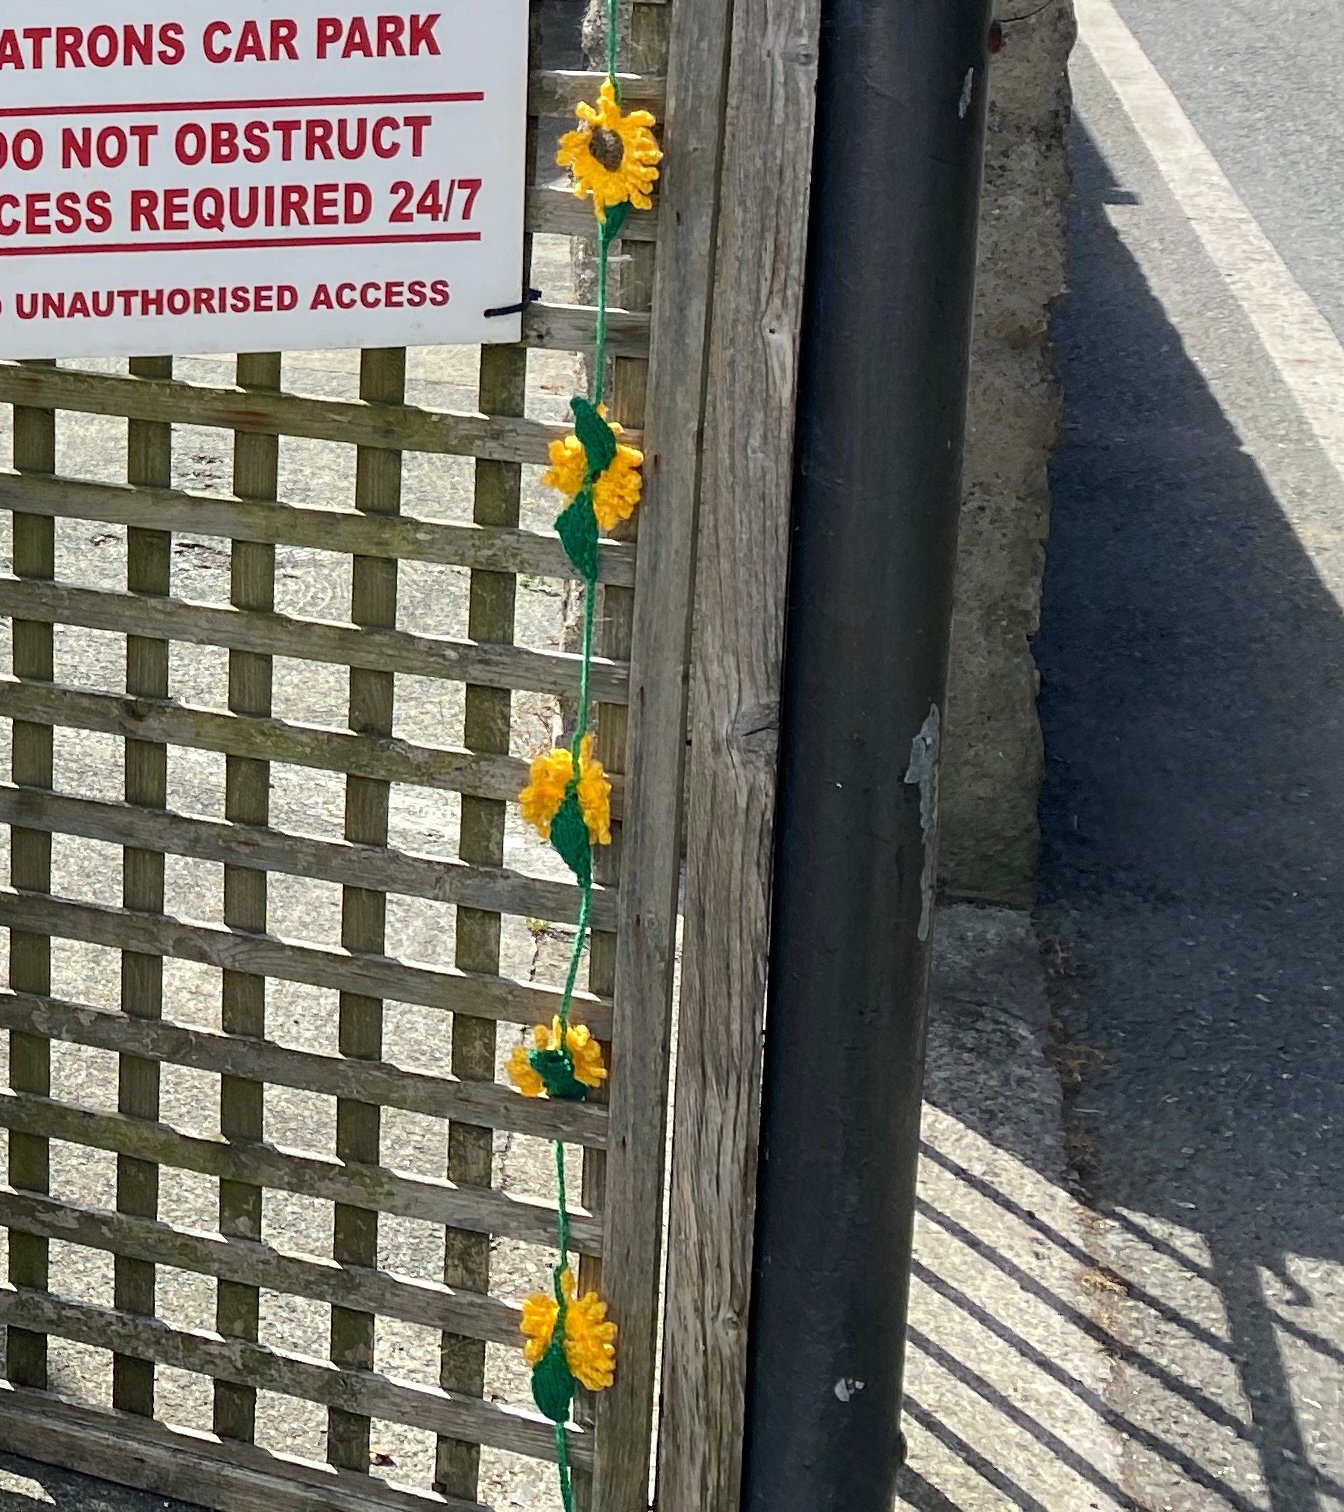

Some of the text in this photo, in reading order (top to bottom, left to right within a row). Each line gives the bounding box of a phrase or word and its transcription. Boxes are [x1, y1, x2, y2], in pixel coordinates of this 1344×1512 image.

[202, 19, 298, 64] CAR
[316, 13, 440, 59] PARK
[61, 124, 158, 168] NOT
[174, 116, 432, 165] OBSTRUCT
[130, 183, 372, 231] REQUIRED
[389, 178, 481, 223] 24/7
[16, 284, 298, 319] UNAUTHORISED
[310, 280, 448, 309] ACCESS
